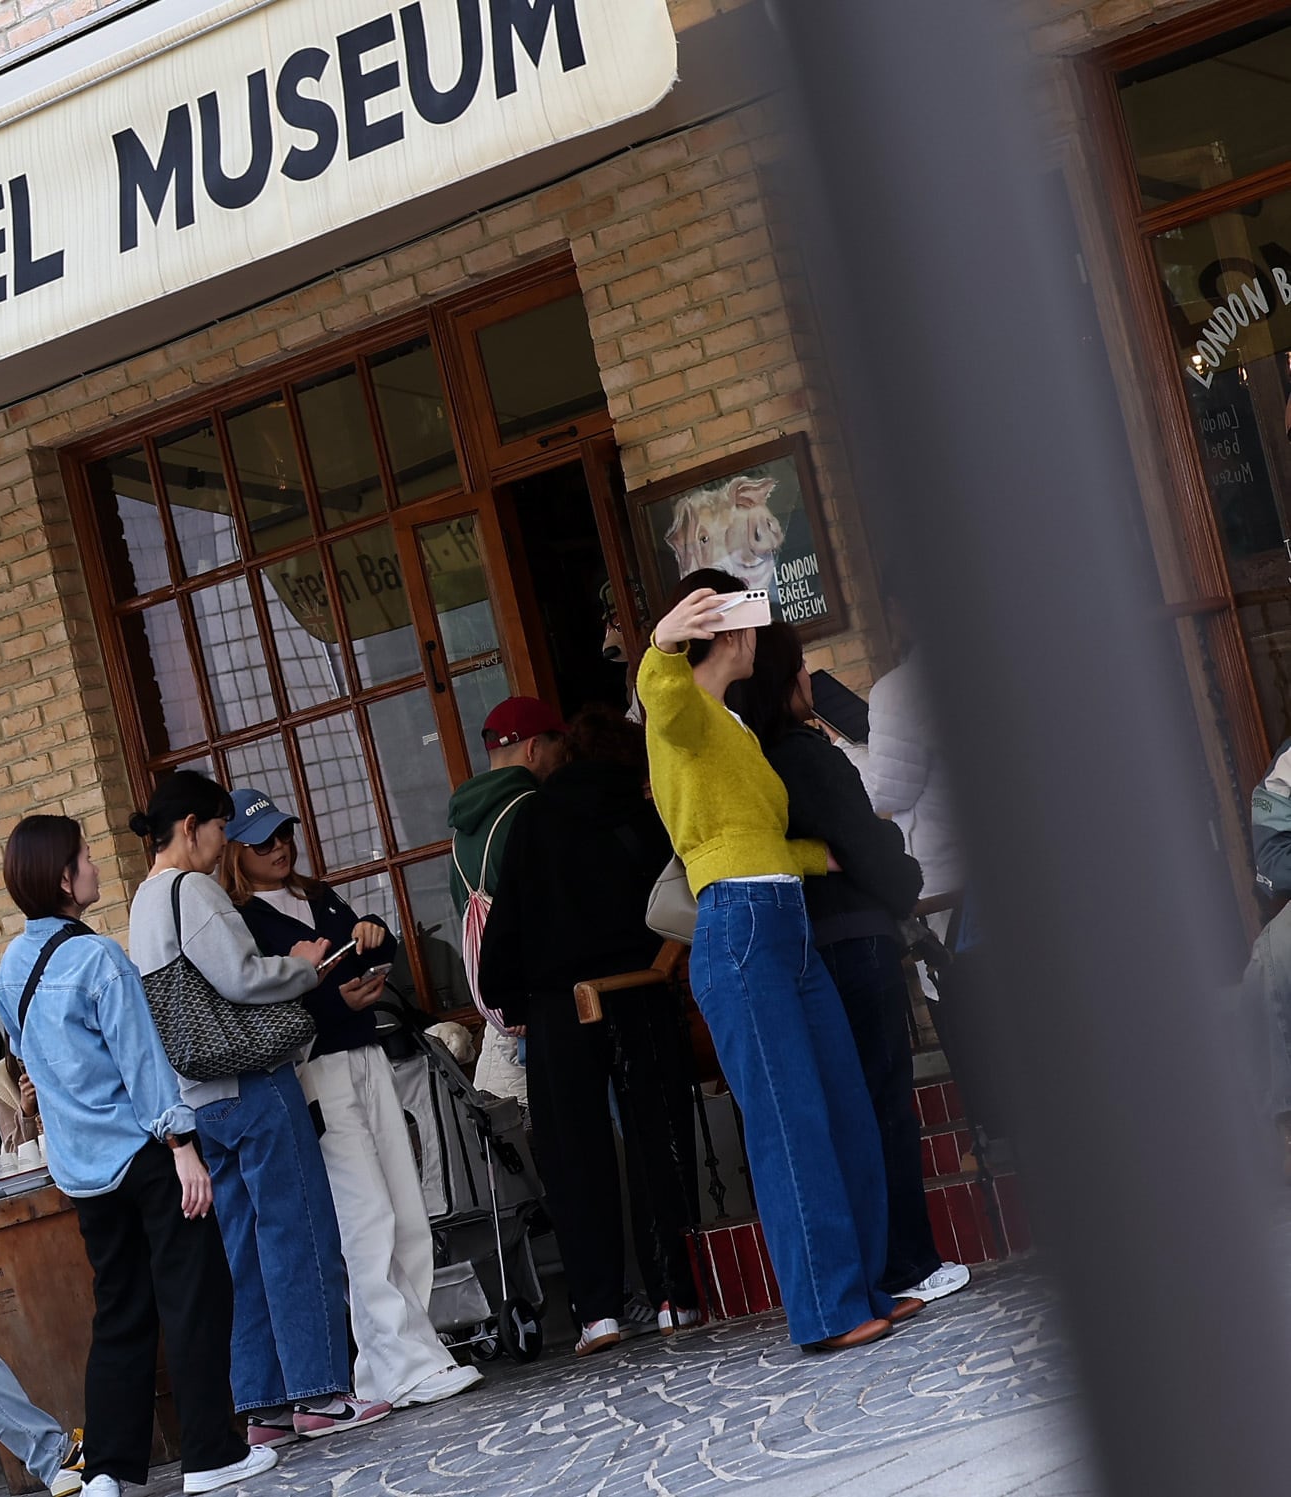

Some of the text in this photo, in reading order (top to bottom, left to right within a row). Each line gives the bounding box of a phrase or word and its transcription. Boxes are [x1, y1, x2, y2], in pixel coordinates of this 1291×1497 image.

[112, 0, 587, 254] MUSEUM
[1186, 267, 1291, 389] LONDON B
[773, 553, 819, 586] LONDON
[777, 579, 815, 605] BAGEL
[781, 594, 828, 623] MUSEUM
